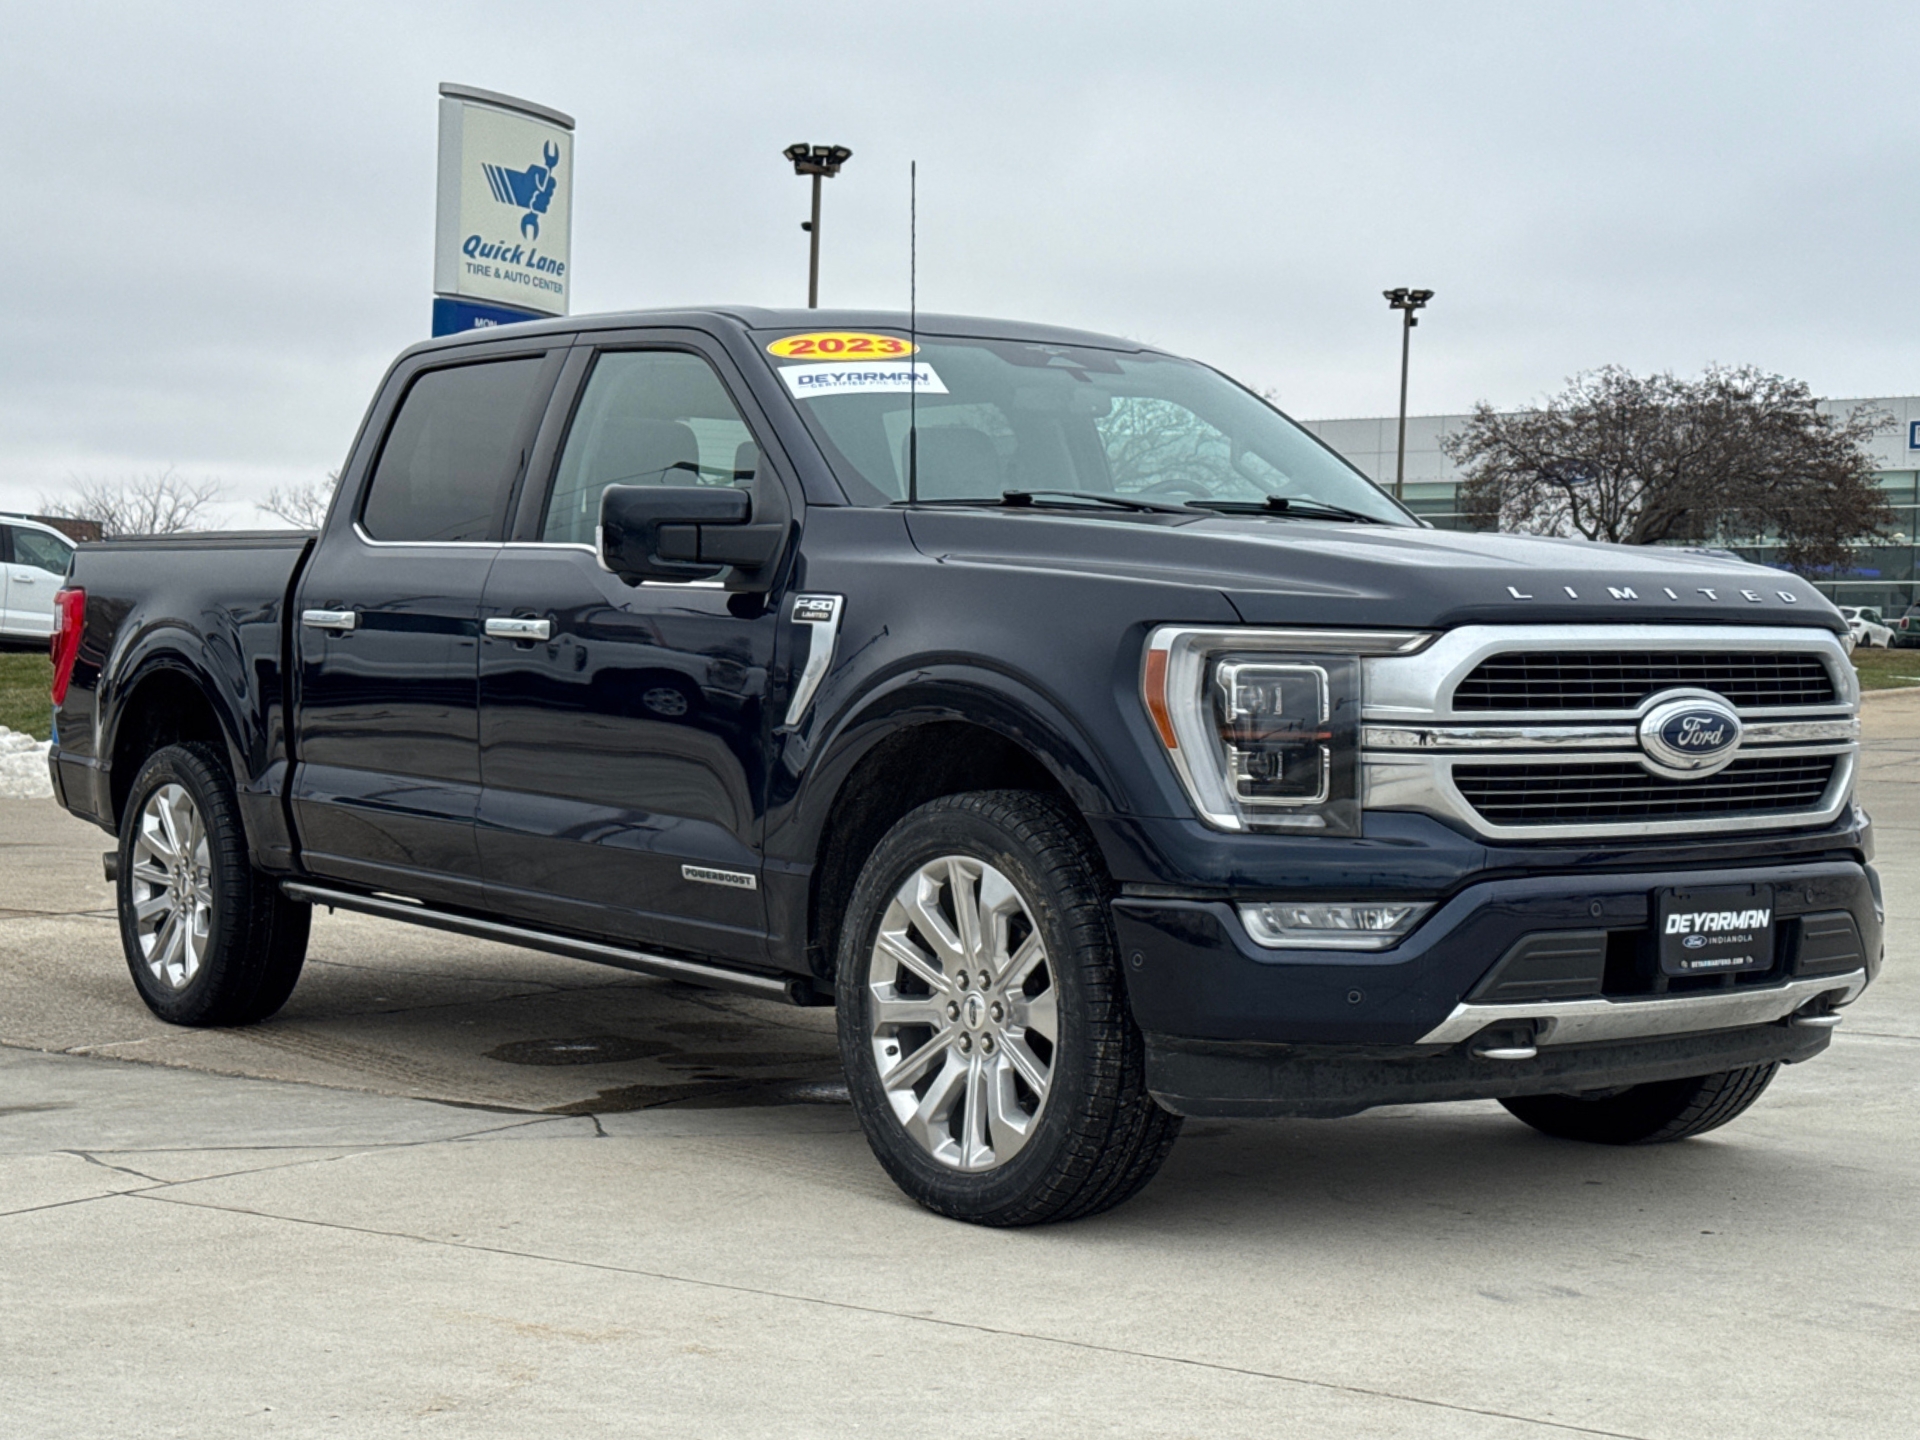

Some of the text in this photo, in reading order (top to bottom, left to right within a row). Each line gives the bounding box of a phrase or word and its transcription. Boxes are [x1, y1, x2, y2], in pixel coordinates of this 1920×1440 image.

[462, 234, 566, 276] Quick Lane
[465, 262, 563, 294] TIRE & AUTO CENTER
[789, 338, 905, 355] 2023
[798, 372, 928, 385] DEYARMAN
[1507, 586, 1797, 602] LIMITED
[1678, 716, 1725, 746] Ford
[684, 868, 751, 885] POWERBOOST
[1665, 909, 1770, 934] DEYARMAN
[1709, 934, 1753, 944] INDIANOLA
